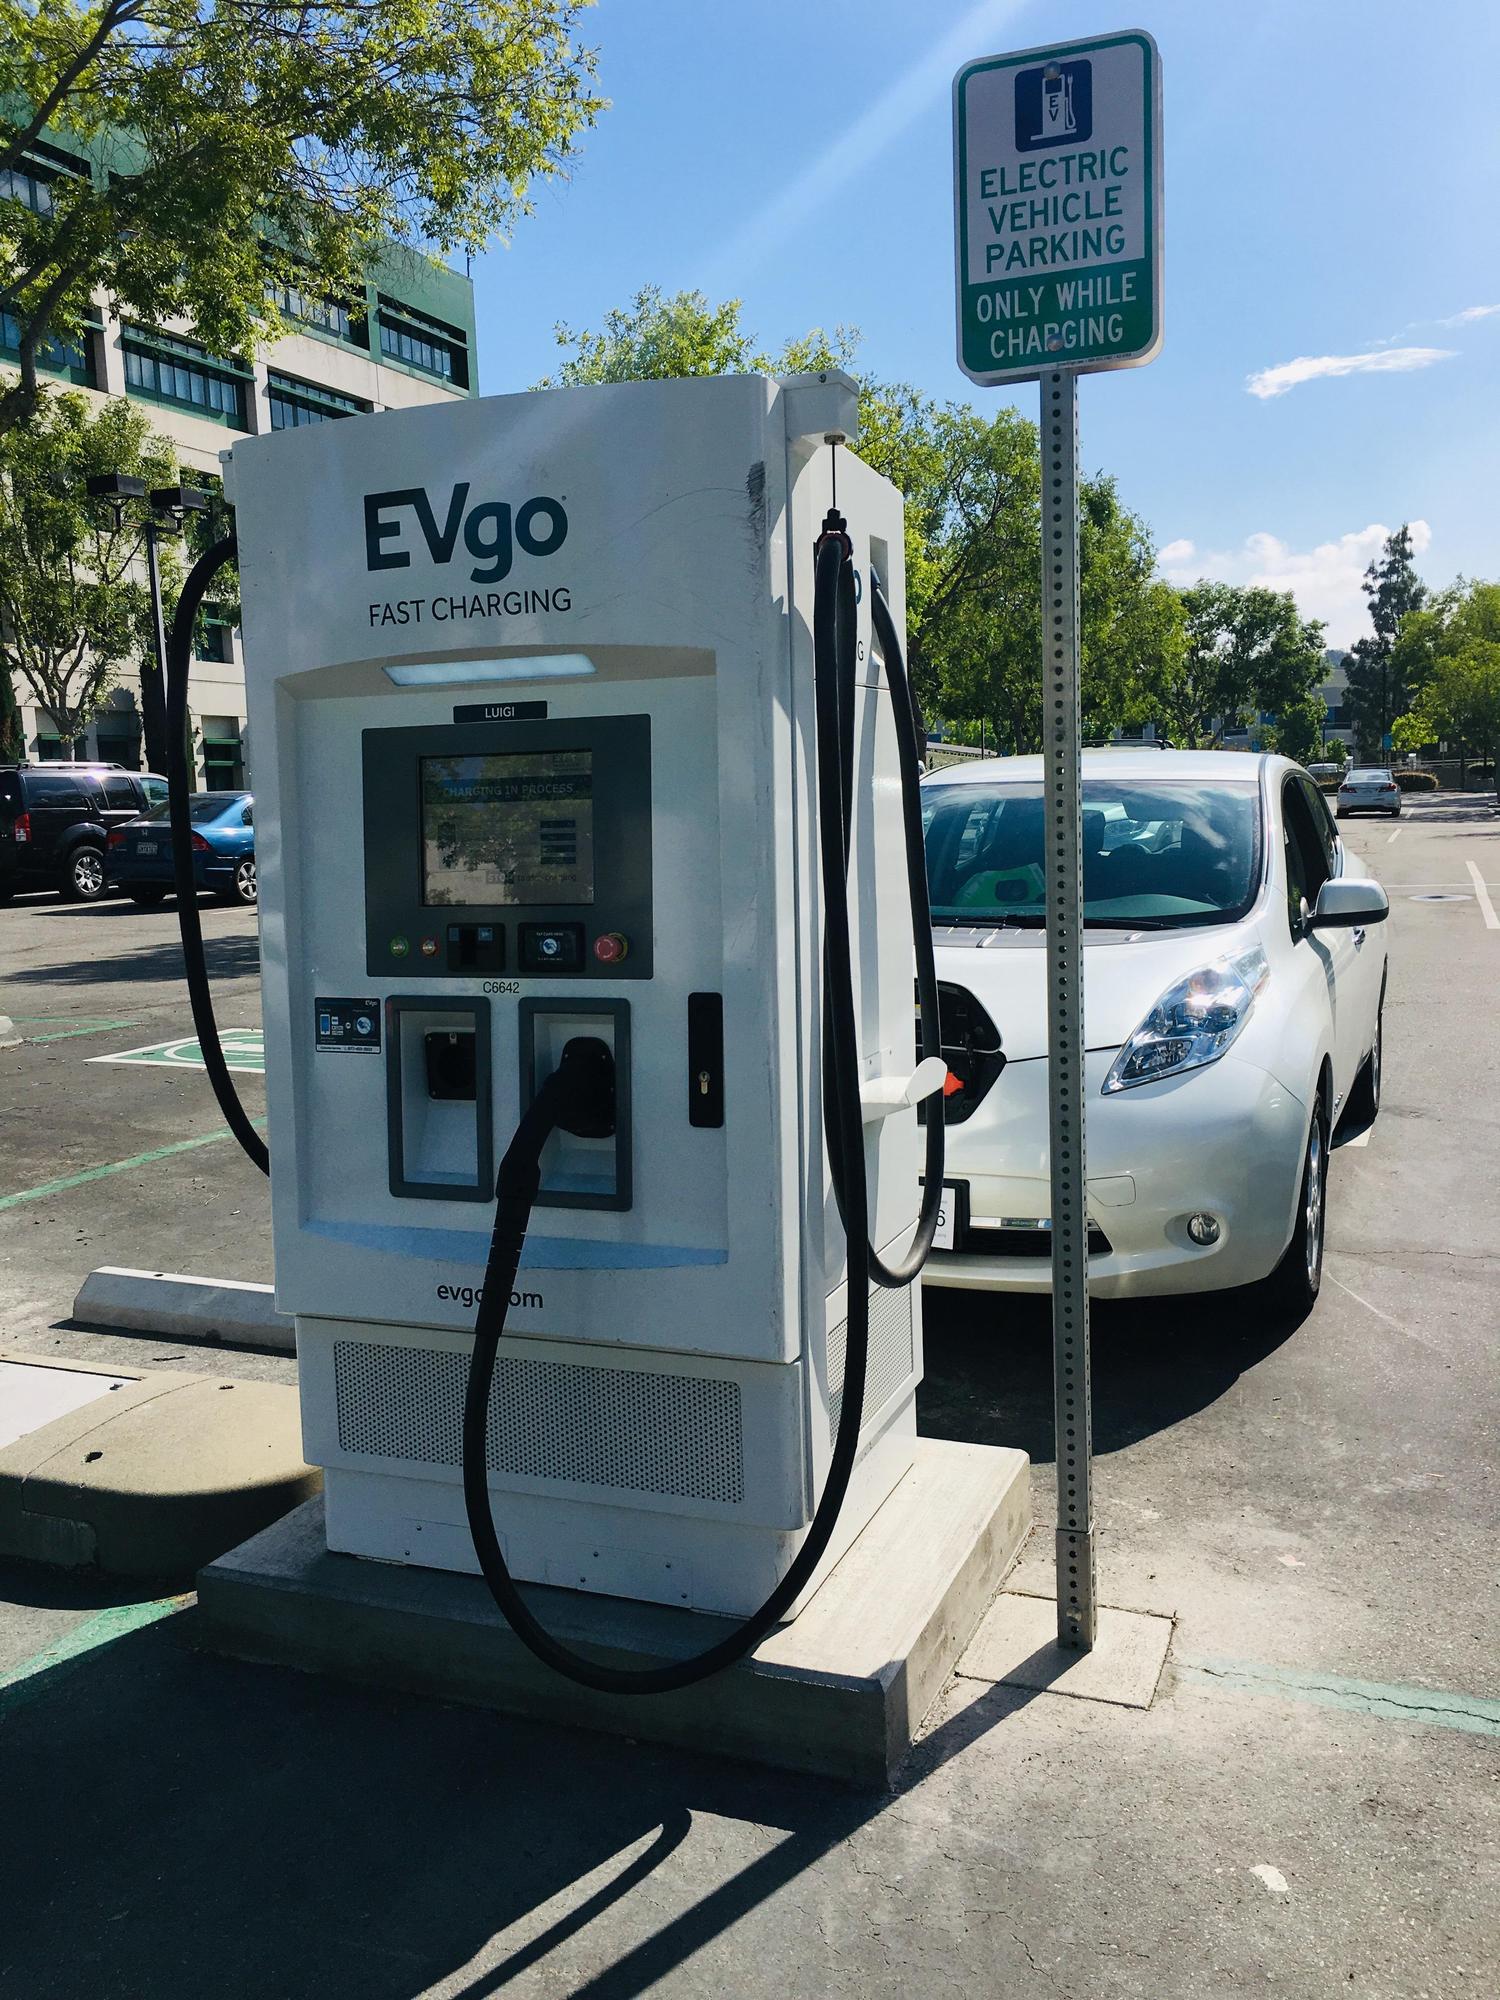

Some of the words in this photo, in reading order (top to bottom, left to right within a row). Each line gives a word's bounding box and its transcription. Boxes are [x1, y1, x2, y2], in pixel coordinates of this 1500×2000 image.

[1048, 94, 1059, 122] EV
[980, 145, 1129, 200] ELECTRIC
[988, 185, 1123, 235] VEHICLE
[985, 224, 1125, 274] PARKING
[976, 286, 1045, 323] ONLY
[1055, 272, 1137, 311] WHILE
[363, 482, 569, 584] EVgo
[369, 599, 425, 627] FAST
[431, 587, 571, 621] CHARGING
[485, 706, 515, 719] LUIGI
[505, 784, 519, 795] IN
[522, 783, 574, 795] PROCESS
[483, 981, 520, 994] C6642
